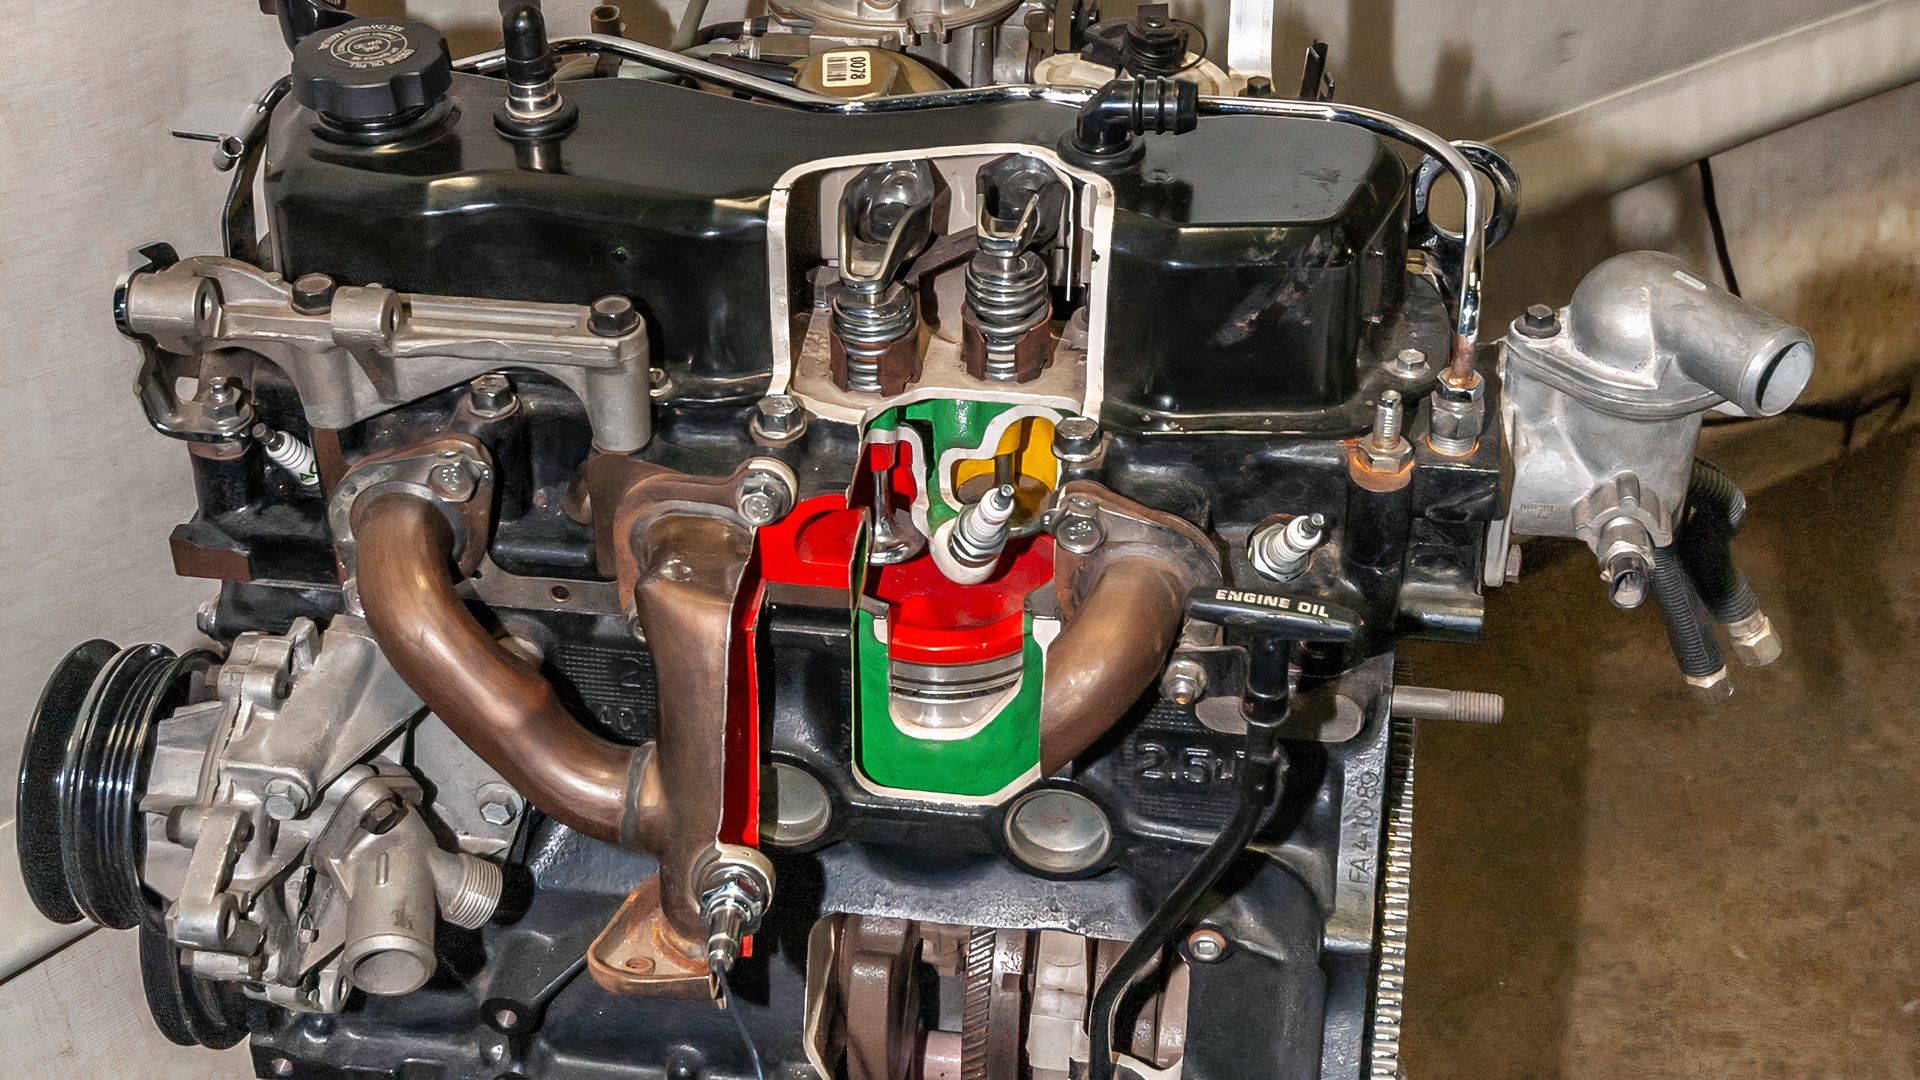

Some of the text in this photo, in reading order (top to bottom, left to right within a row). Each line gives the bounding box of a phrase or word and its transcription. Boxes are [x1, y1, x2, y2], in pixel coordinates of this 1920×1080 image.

[850, 56, 866, 80] 0078
[1215, 589, 1329, 618] ENGINE OIL
